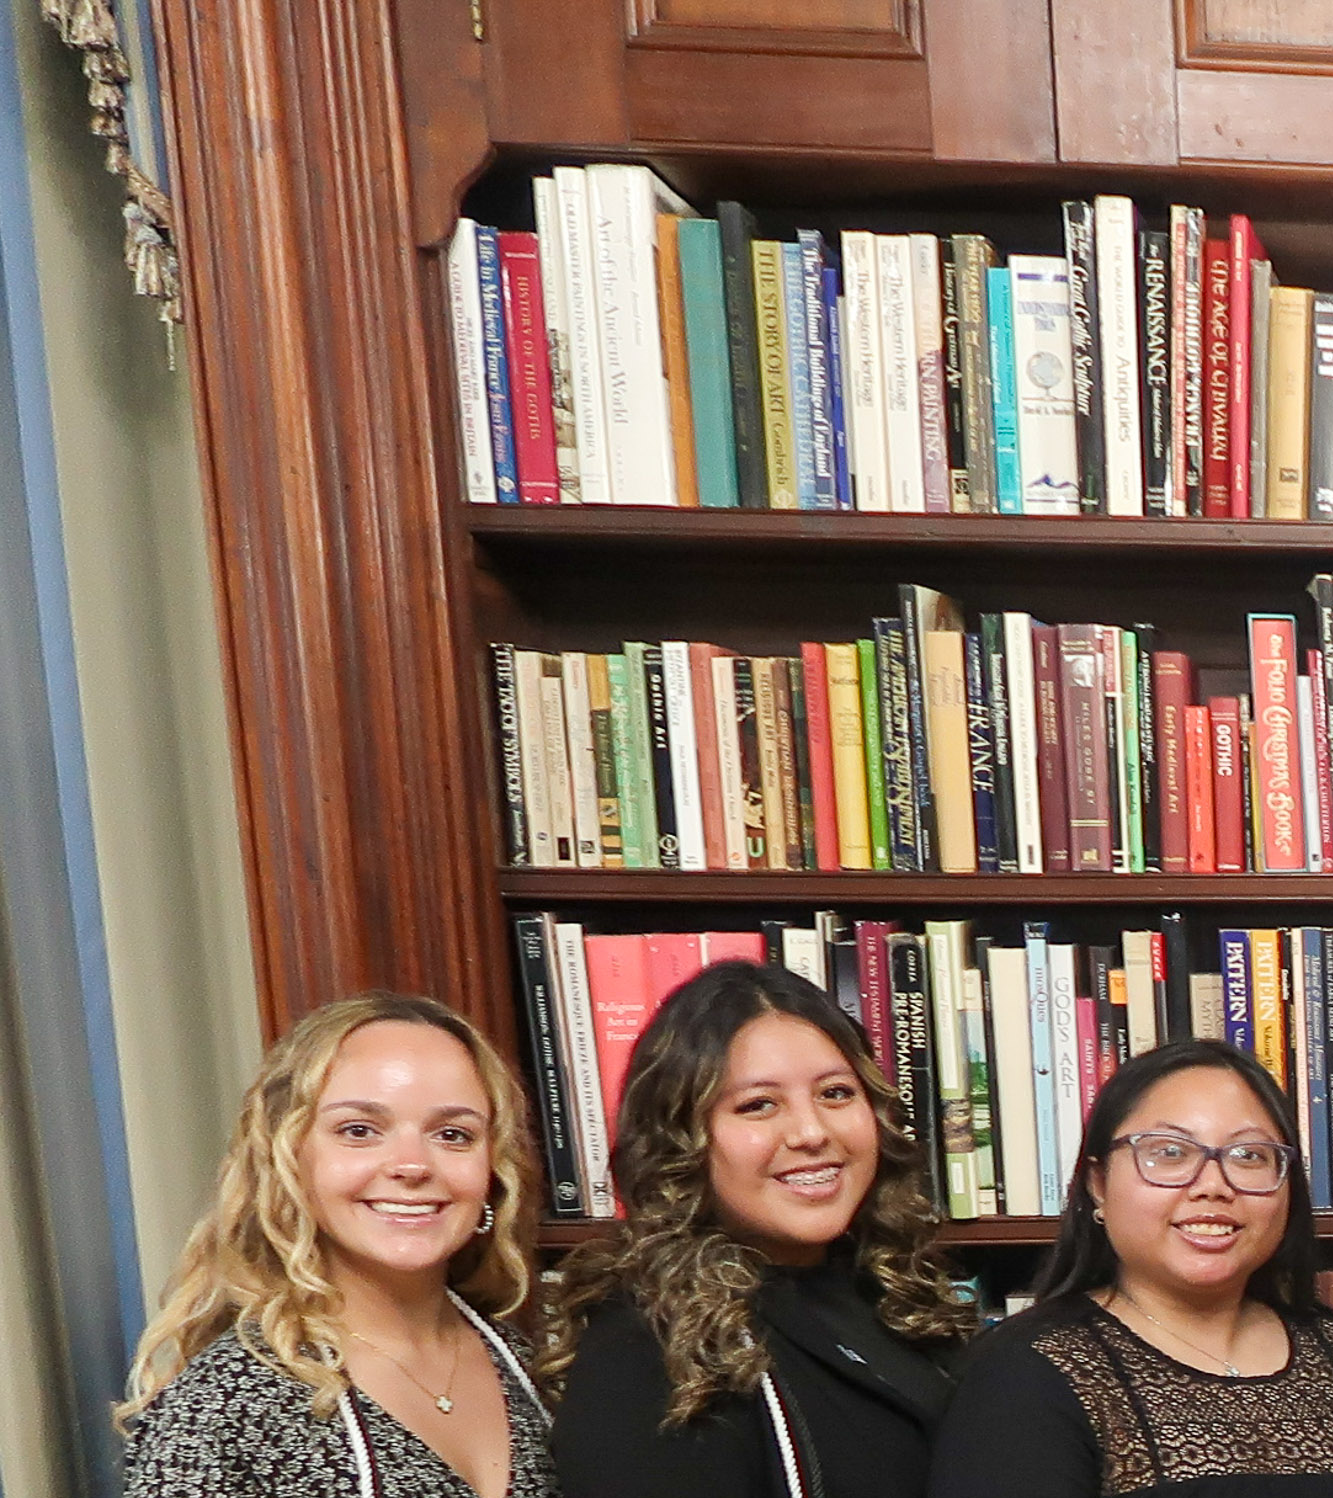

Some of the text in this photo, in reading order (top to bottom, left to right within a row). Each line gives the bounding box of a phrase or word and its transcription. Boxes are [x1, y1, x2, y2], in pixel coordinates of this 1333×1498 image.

[477, 233, 503, 390] Life in Medieval France
[566, 204, 595, 459] OLD MASTER PAINTINGS IN NORTH AMERICA
[597, 215, 630, 424] Art of the Ancient World
[786, 262, 804, 295] THE
[1145, 258, 1166, 386] RENAISSANCE
[517, 276, 540, 439] HISTORY OF THE GOTHS
[758, 252, 786, 415] THE STORY OF ART
[803, 249, 832, 477] The Traditional Buildings of England
[857, 271, 874, 408] The Western Heritage
[890, 275, 908, 411] The Western Heritage
[1114, 354, 1133, 442] Antiquities
[772, 423, 789, 485] Gombrich
[968, 703, 994, 793] FRANCE
[1164, 705, 1178, 813] Early Medieval Art
[1215, 724, 1232, 776] GOTHIC
[597, 1002, 645, 1014] Religious
[909, 991, 926, 1049] SPANISH
[1225, 941, 1248, 1023] PATTERN
[1256, 941, 1276, 1021] PATTERN
[564, 940, 601, 1162] THE ROMANESQUE FRIEZE AND ITS SPECTATOR
[1058, 1052, 1074, 1098] ART
